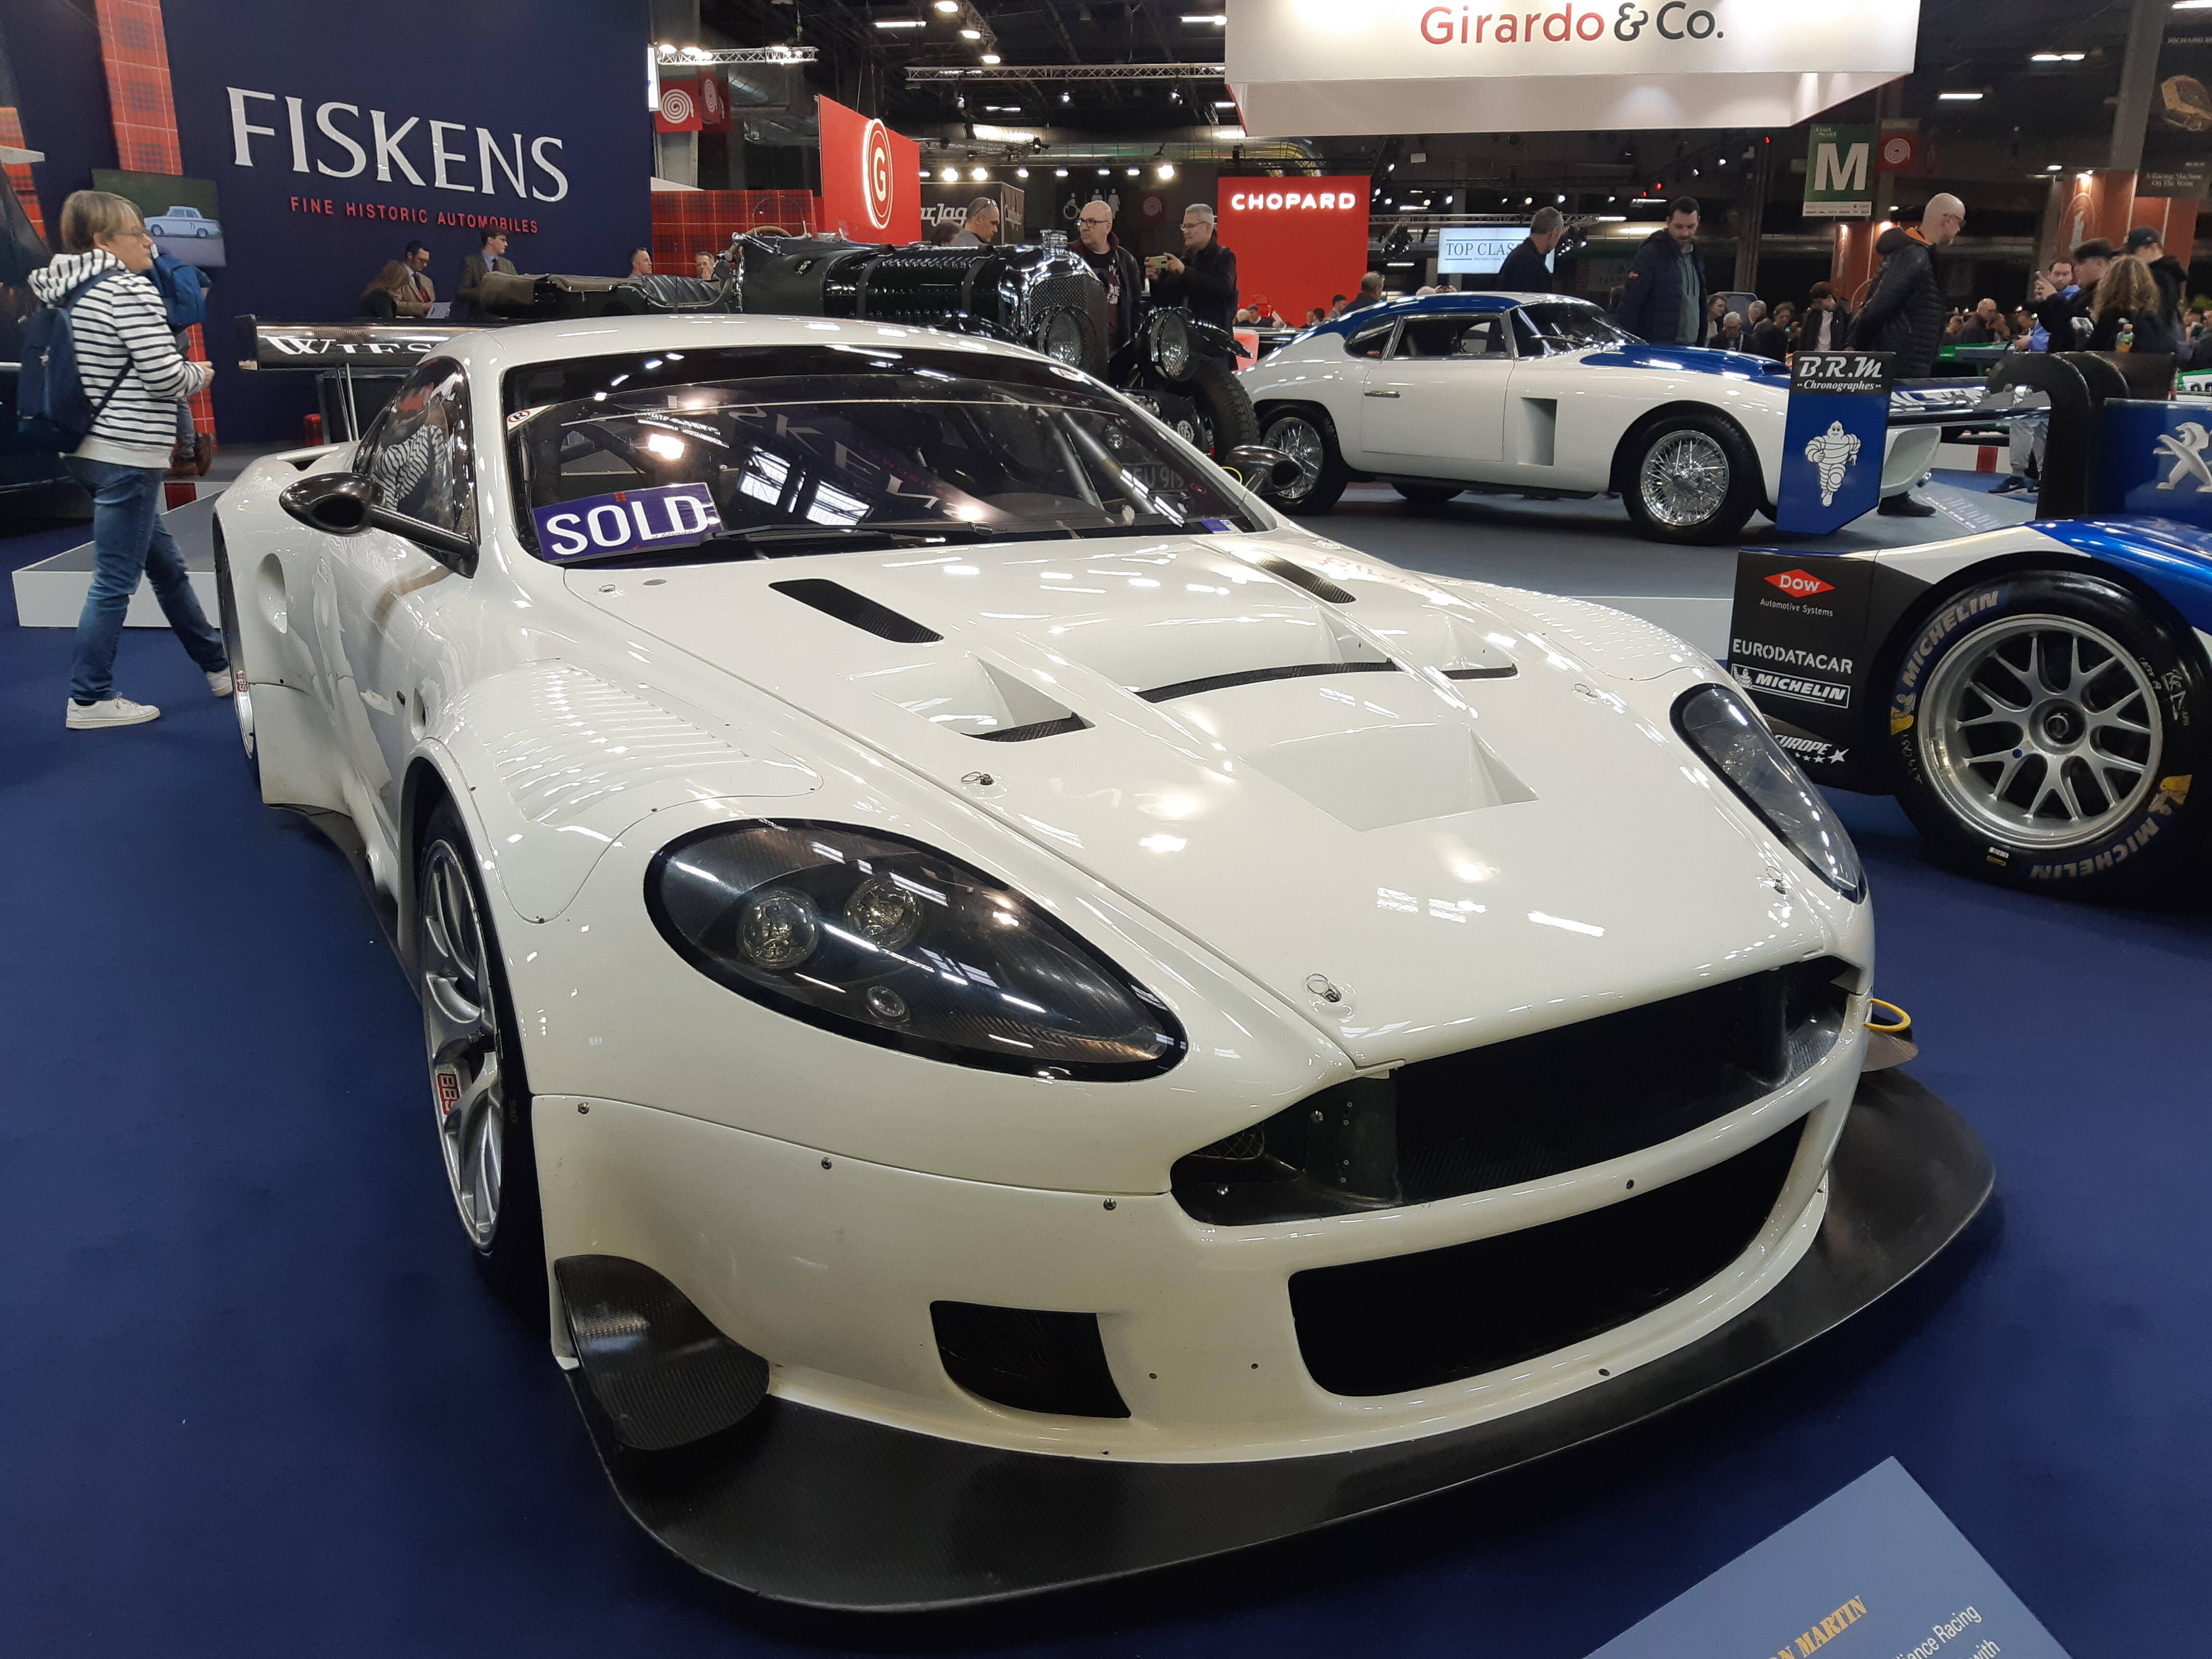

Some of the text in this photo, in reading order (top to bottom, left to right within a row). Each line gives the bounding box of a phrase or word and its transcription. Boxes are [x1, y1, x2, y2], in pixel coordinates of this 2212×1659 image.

[1420, 1, 1724, 45] Girardo & Co.
[226, 86, 568, 203] FISKENS
[1815, 143, 1869, 190] M
[290, 196, 538, 233] FINE HISTORIC AUTOMOBILES
[1231, 193, 1356, 210] CHOPARD
[1446, 243, 1521, 256] TOP CLAS
[546, 495, 709, 555] SOLD
[1779, 574, 1821, 592] DOW
[1760, 598, 1834, 617] Automotive Systems
[1732, 638, 1853, 674] EURODATACAR
[1902, 590, 1998, 687] MICHELIN
[1755, 673, 1846, 701] MICHELIN
[2030, 817, 2160, 879] MICHELIN
[1794, 1595, 1868, 1659] MARTIN
[1932, 1605, 1982, 1644] Racing
